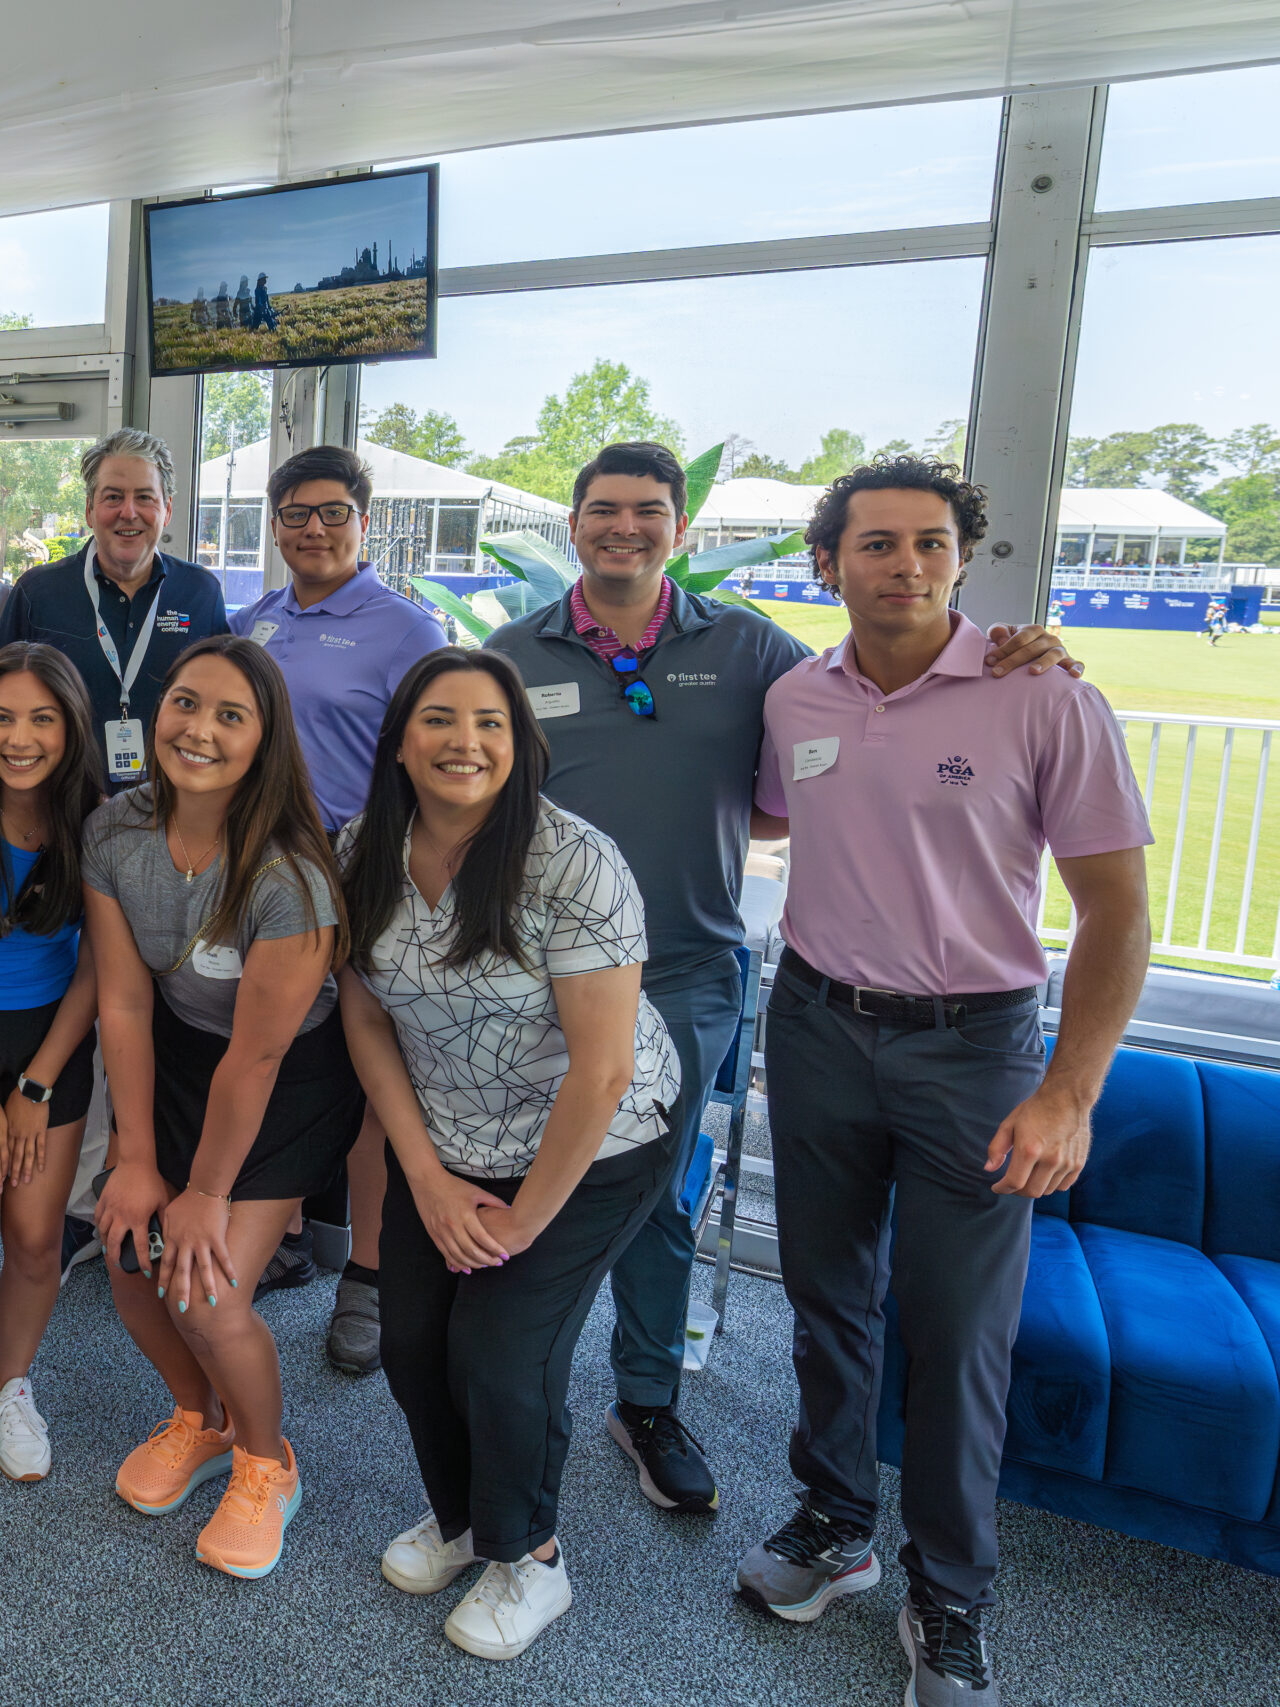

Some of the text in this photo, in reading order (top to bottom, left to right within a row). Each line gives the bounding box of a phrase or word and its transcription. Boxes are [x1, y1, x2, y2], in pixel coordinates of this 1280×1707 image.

[678, 672, 717, 681] first tee
[937, 763, 975, 776] PGA
